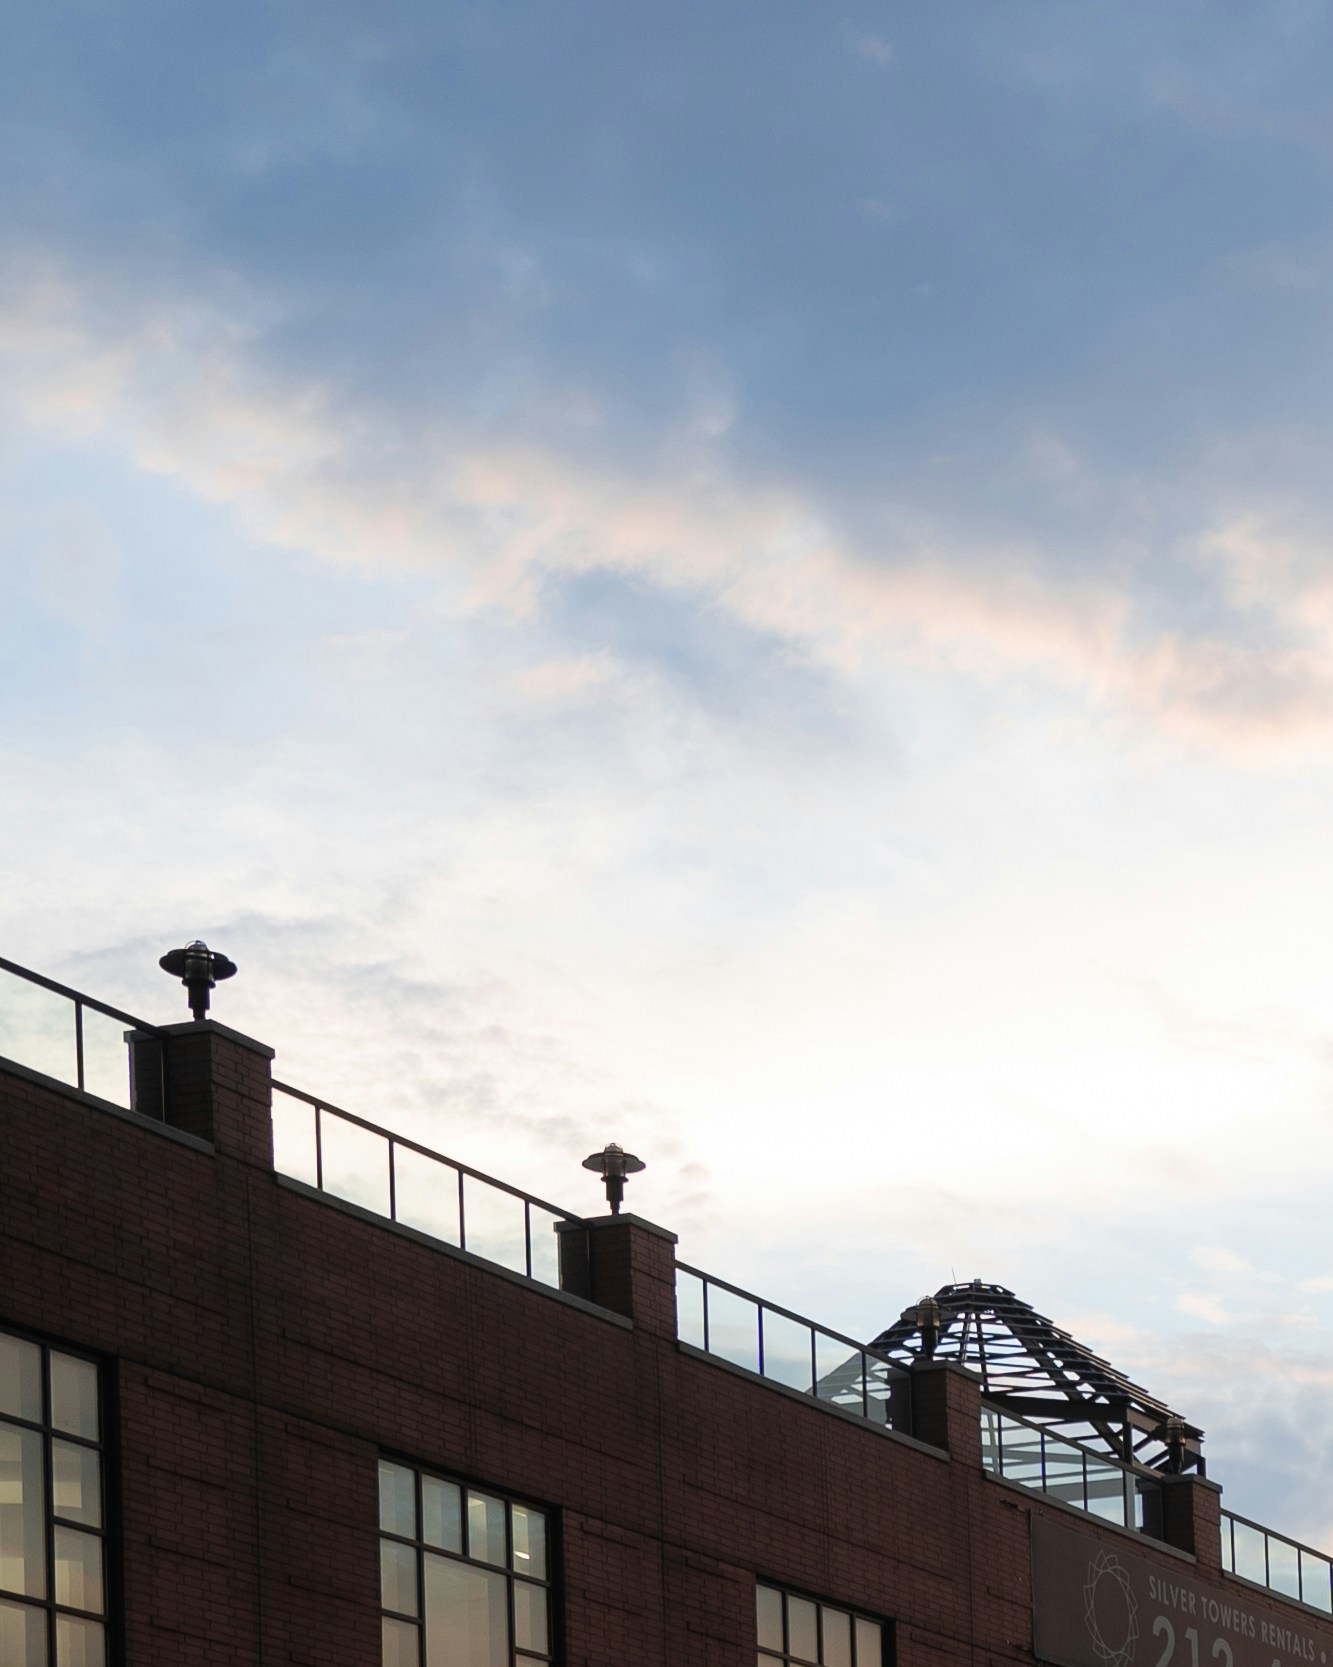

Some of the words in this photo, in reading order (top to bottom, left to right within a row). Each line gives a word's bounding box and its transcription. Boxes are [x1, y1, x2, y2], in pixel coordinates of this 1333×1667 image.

[1149, 1575, 1197, 1616] SILVER
[1201, 1597, 1256, 1639] TOWERS
[1261, 1620, 1315, 1662] RENTALS
